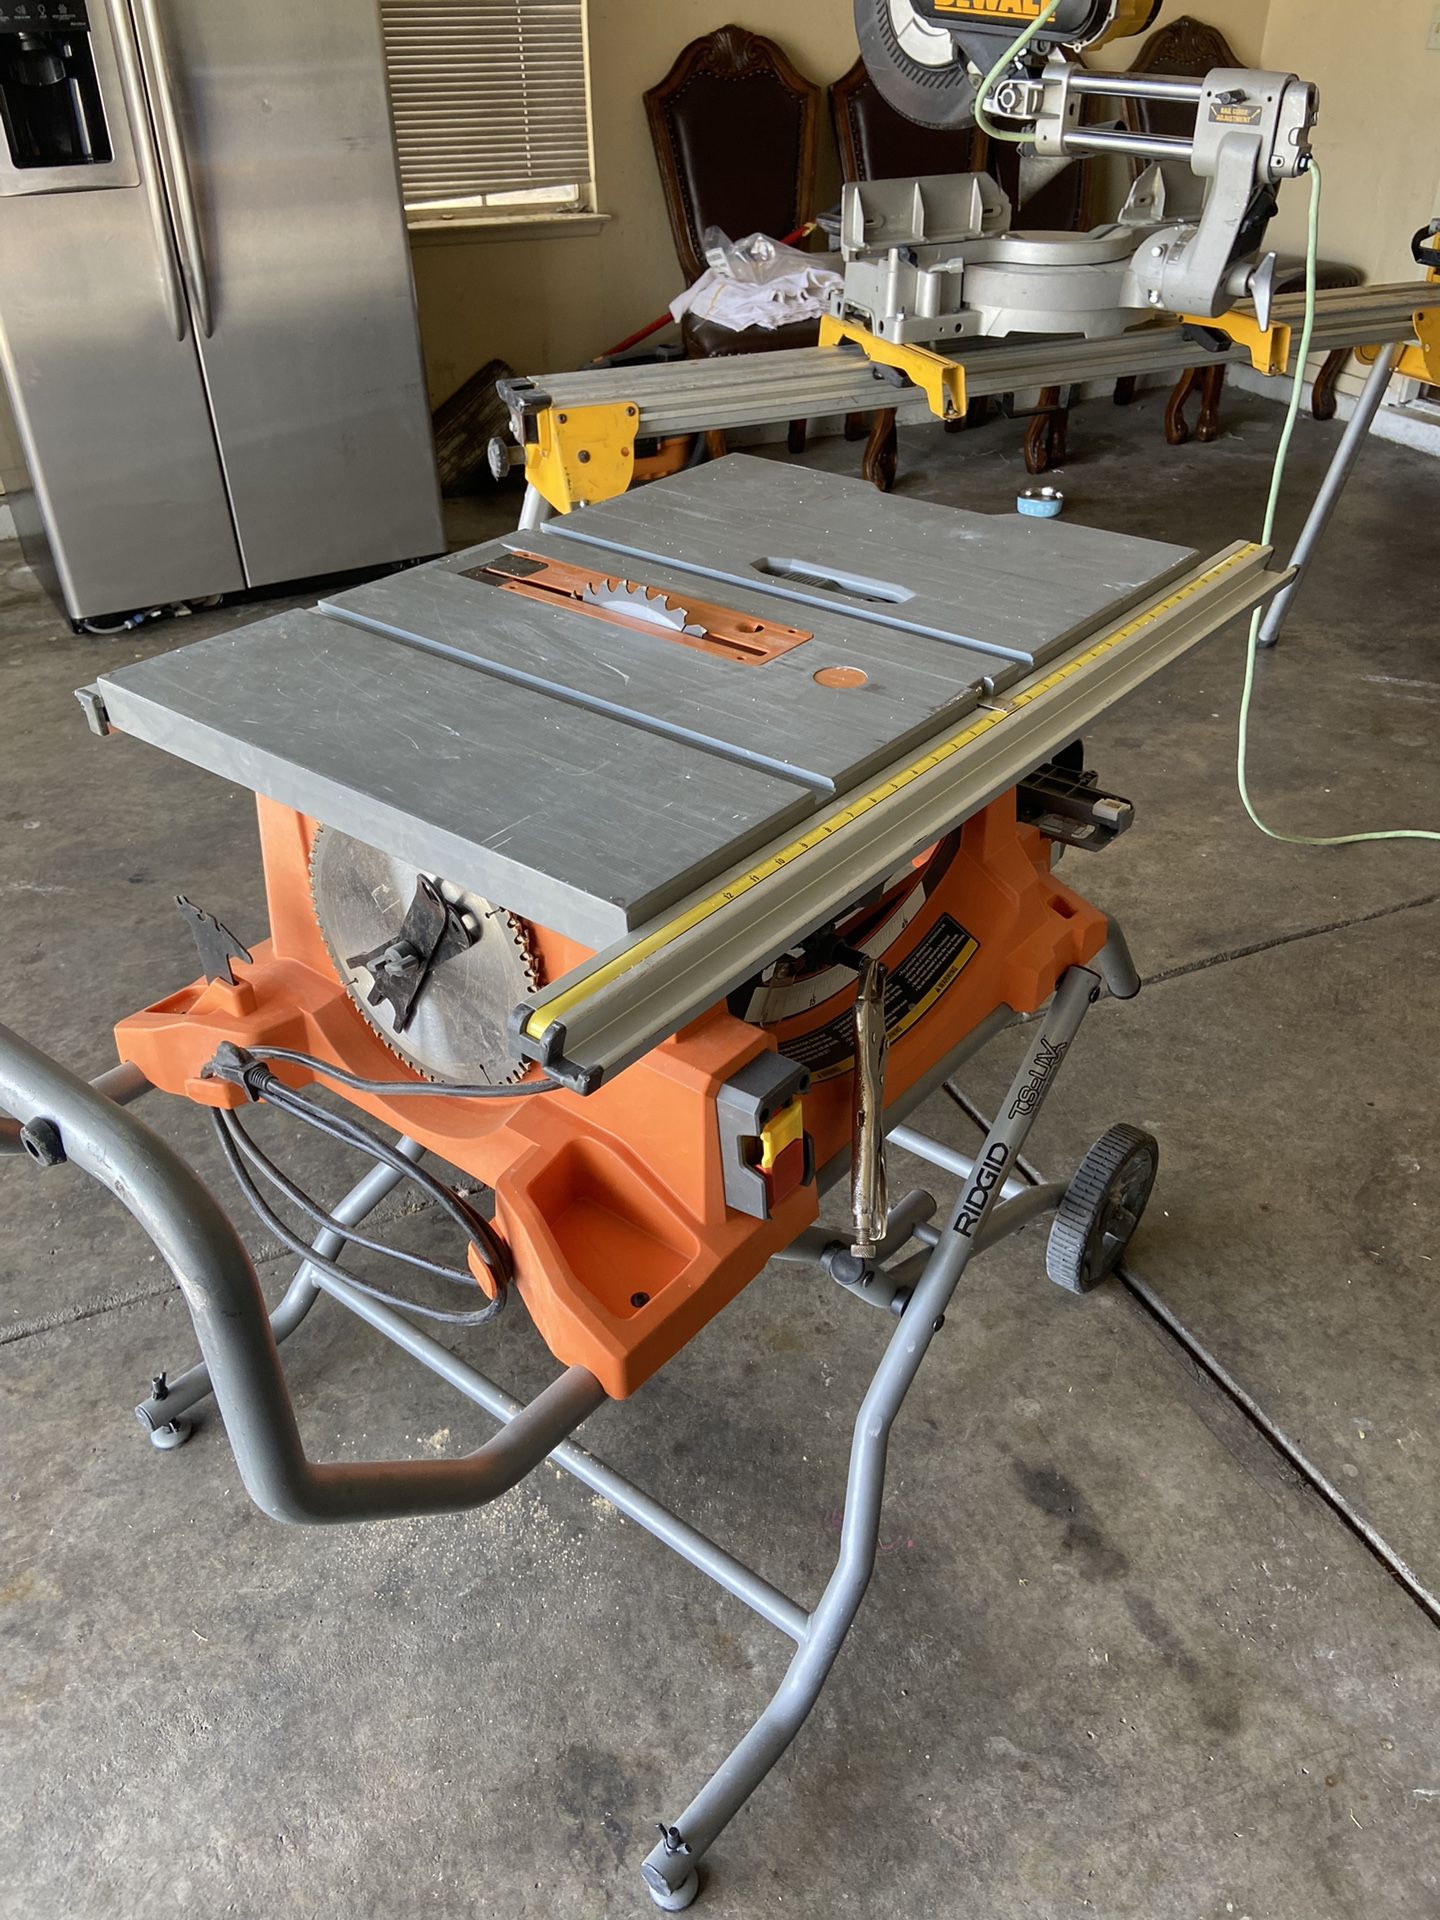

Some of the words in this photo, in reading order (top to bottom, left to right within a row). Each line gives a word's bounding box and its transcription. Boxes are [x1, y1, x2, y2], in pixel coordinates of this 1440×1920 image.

[934, 0, 1056, 16] WAL
[775, 857, 786, 866] 10
[749, 875, 760, 883] 11
[722, 891, 735, 900] 12
[953, 1142, 1010, 1239] RIDGID
